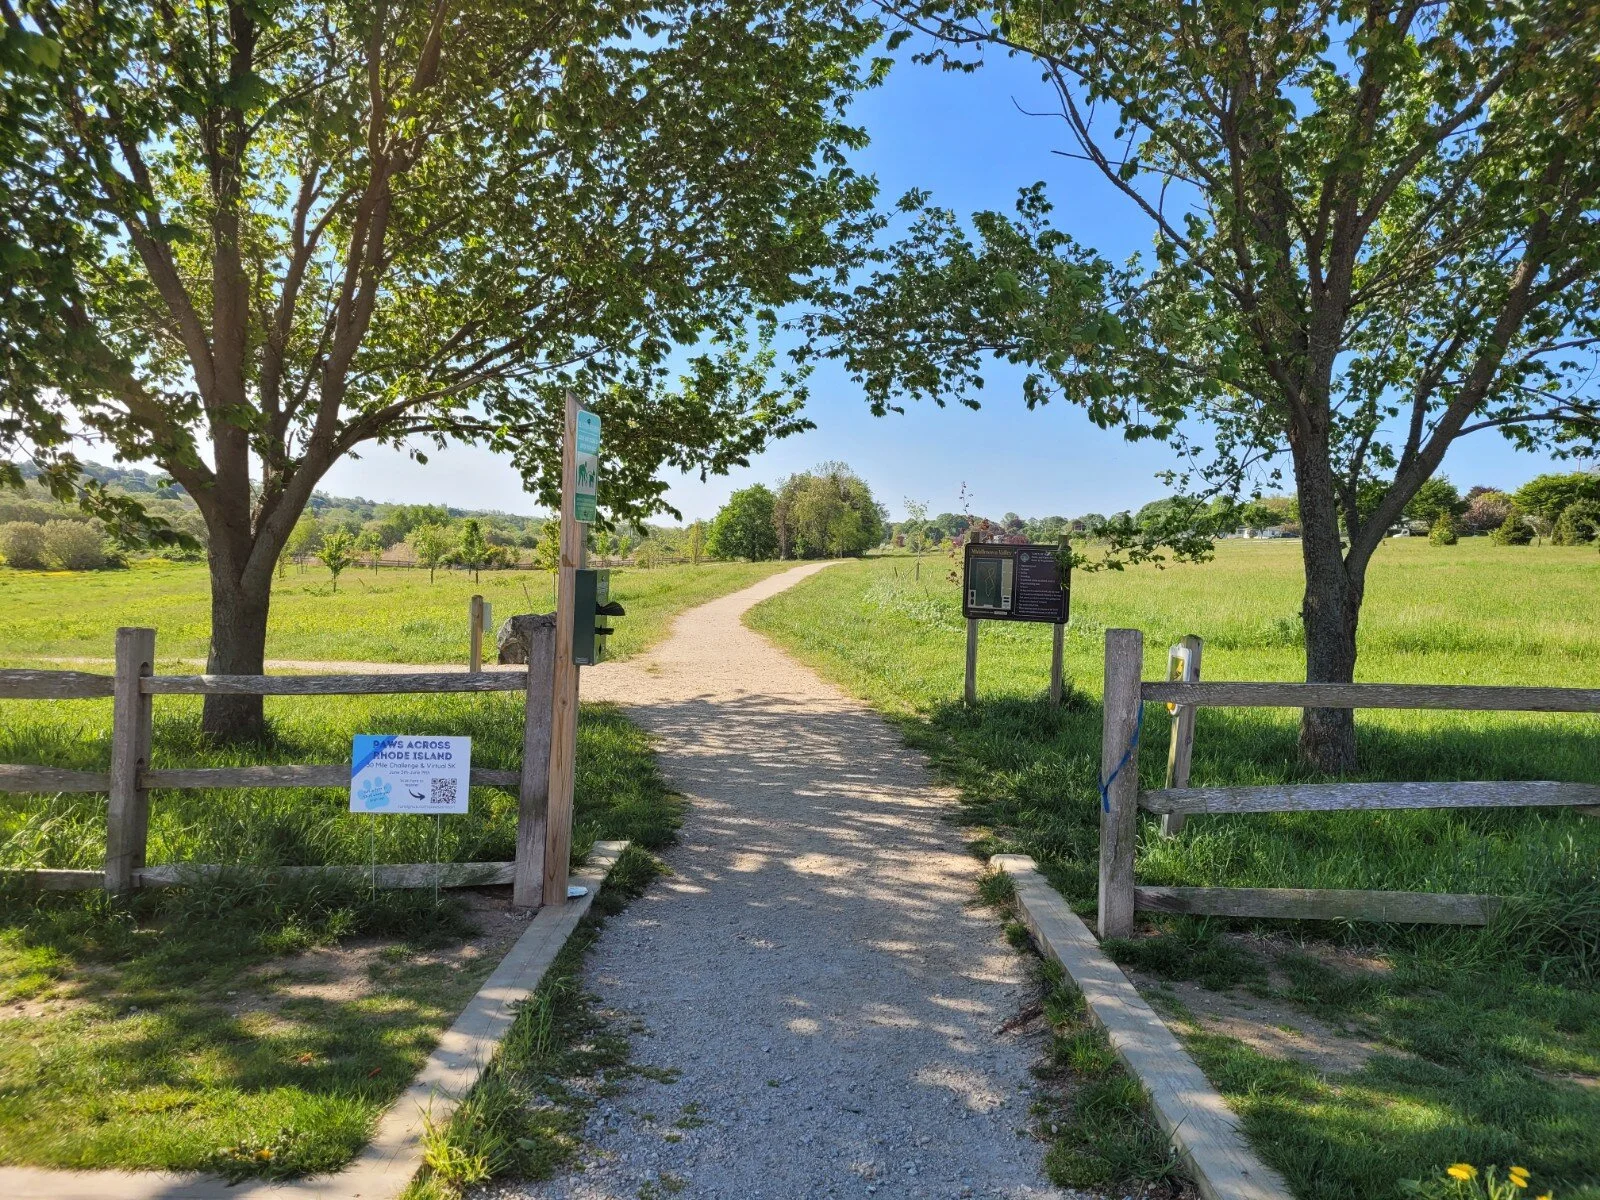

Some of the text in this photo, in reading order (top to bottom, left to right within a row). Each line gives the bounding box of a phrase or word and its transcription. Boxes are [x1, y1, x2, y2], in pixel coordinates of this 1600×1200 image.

[373, 740, 451, 749] PAWS ACROSS
[373, 751, 453, 761] RHODE ISLAND
